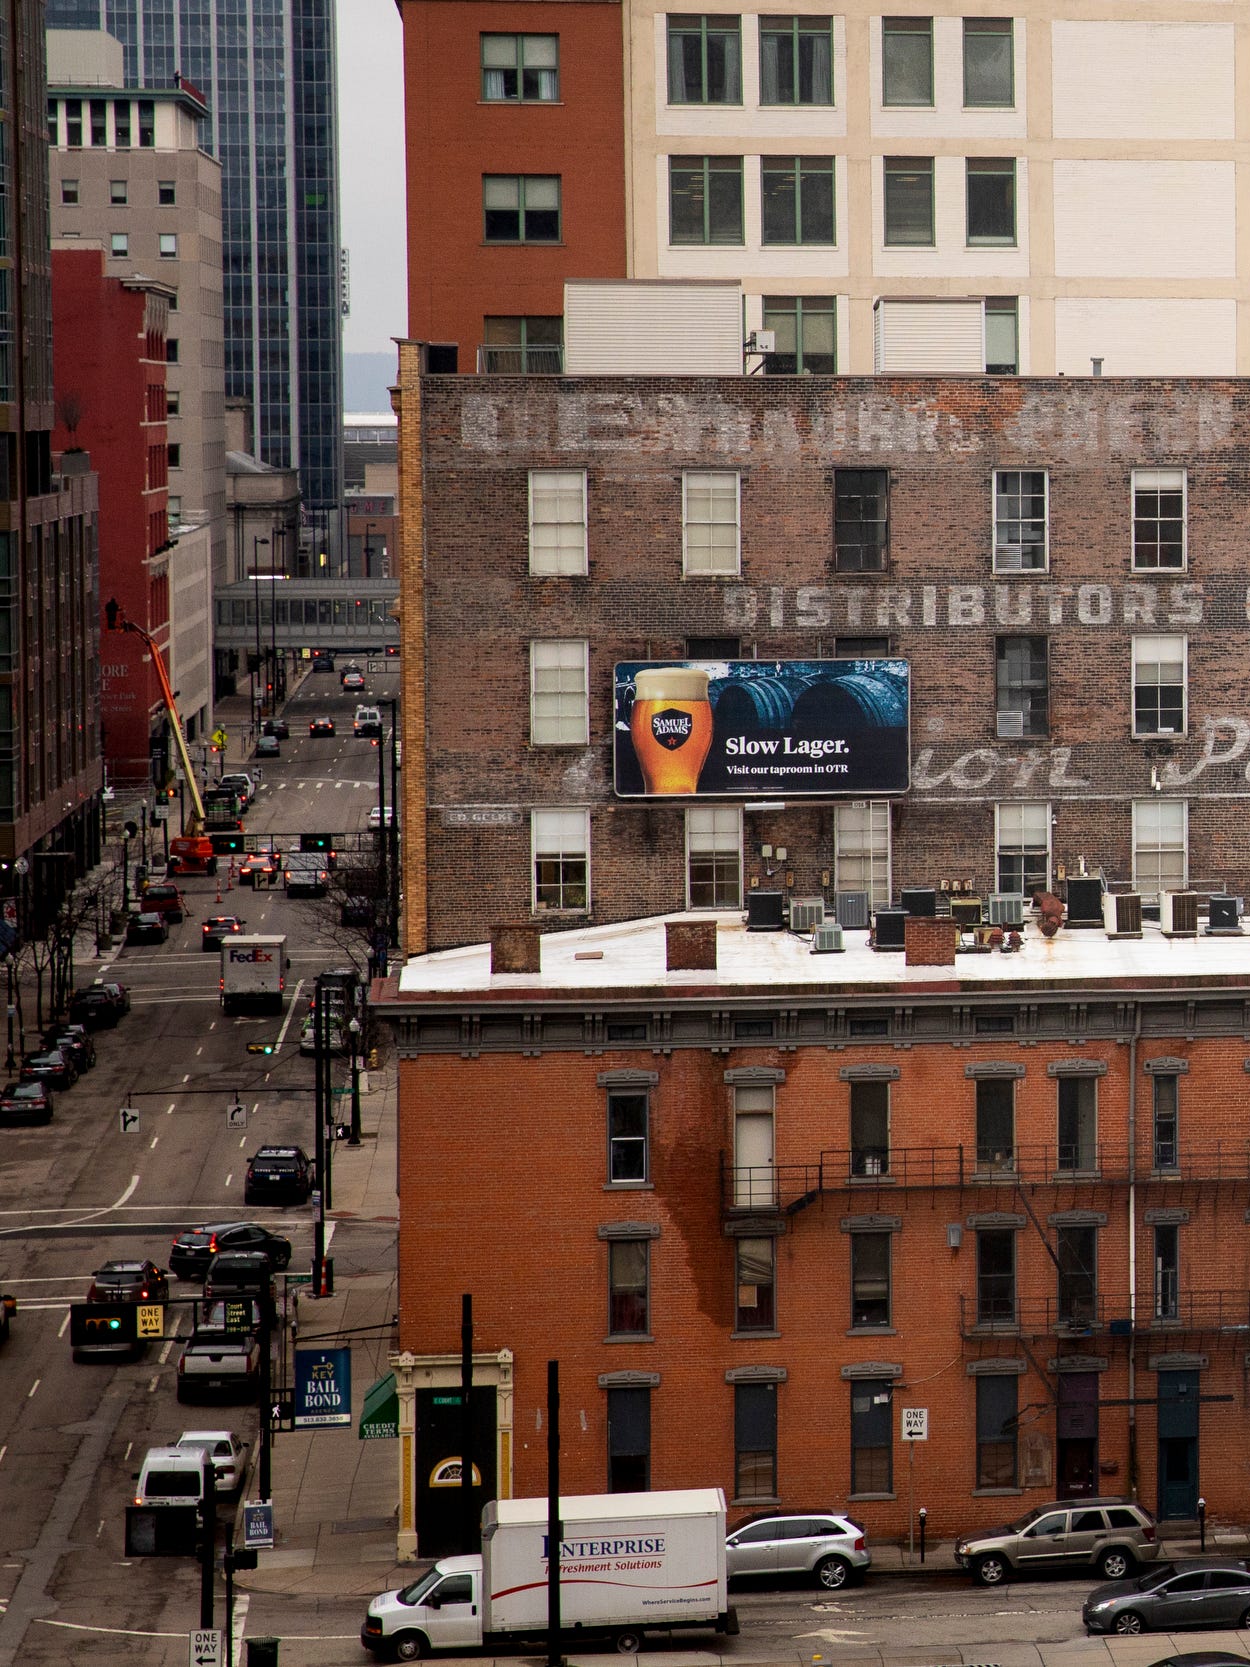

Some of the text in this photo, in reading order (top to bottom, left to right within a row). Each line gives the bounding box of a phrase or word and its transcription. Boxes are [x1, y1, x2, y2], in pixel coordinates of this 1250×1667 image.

[723, 583, 1203, 627] DISTRIBUTORS
[653, 717, 692, 728] SAMUEL
[655, 725, 689, 735] ADAMS
[725, 736, 850, 759] Slow Lager.
[726, 764, 849, 777] Visit our taproom in OTR
[230, 949, 273, 963] FedEx
[141, 1308, 159, 1318] ONE
[141, 1318, 160, 1327] WAY
[312, 1371, 334, 1379] KEY
[307, 1380, 339, 1394] BAIL
[305, 1393, 341, 1407] BOND
[906, 1411, 924, 1419] ONE
[906, 1420, 924, 1428] WAY
[250, 1521, 267, 1529] BAIL
[249, 1528, 268, 1536] BOND
[545, 1559, 662, 1575] freshment Solutions
[642, 1597, 711, 1605] WhereServiceBegins.com
[195, 1633, 217, 1643] ONE
[195, 1644, 217, 1654] WAY
